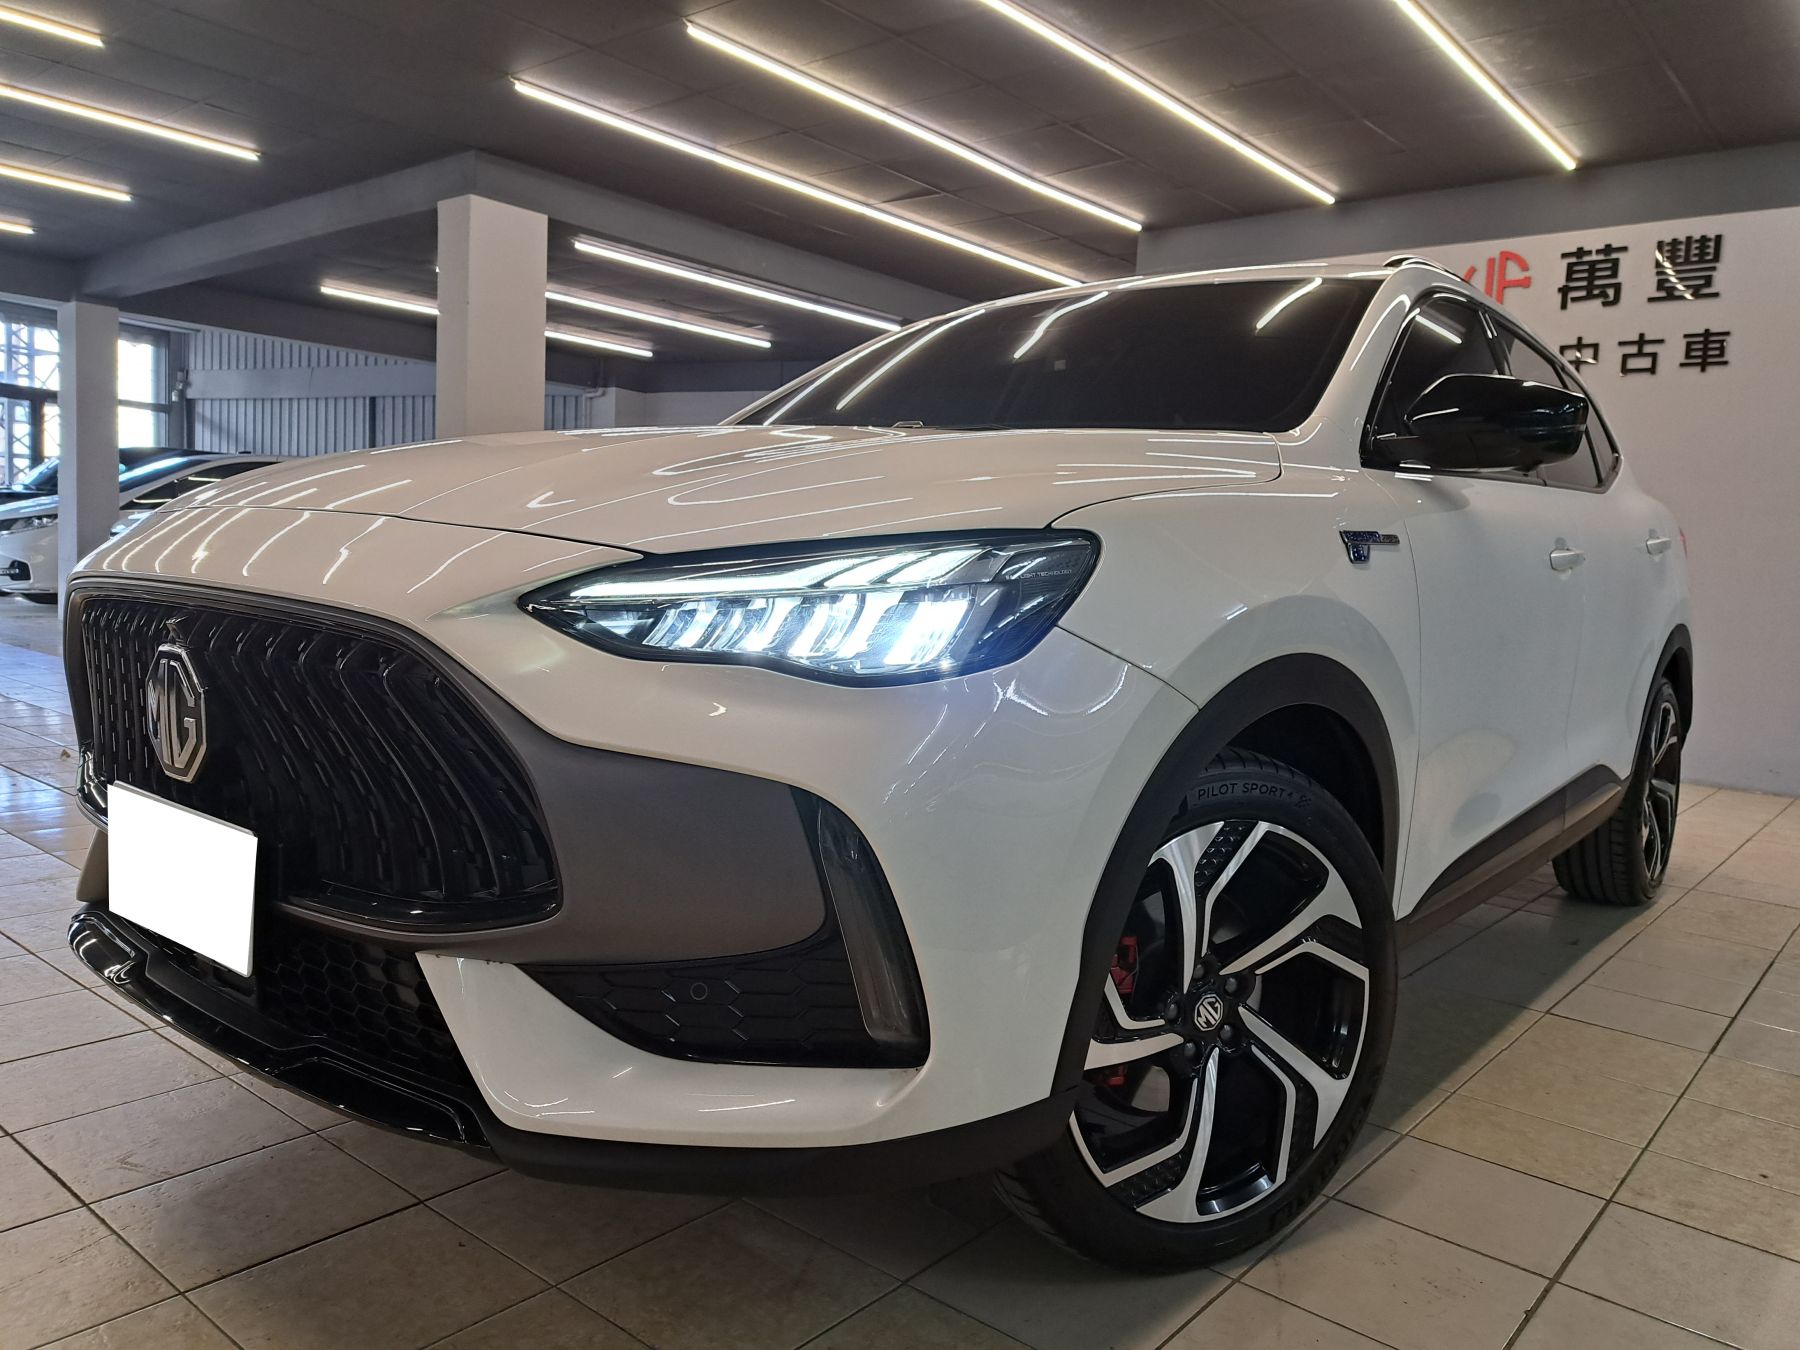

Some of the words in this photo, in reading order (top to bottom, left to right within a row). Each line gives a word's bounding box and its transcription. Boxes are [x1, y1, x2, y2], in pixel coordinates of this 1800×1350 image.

[1557, 234, 1723, 310] 萬豐
[1559, 328, 1731, 375] 中古車
[148, 658, 197, 769] MG
[1198, 782, 1238, 800] PILOT
[1242, 782, 1286, 798] SPORT
[1197, 997, 1221, 1028] MG
